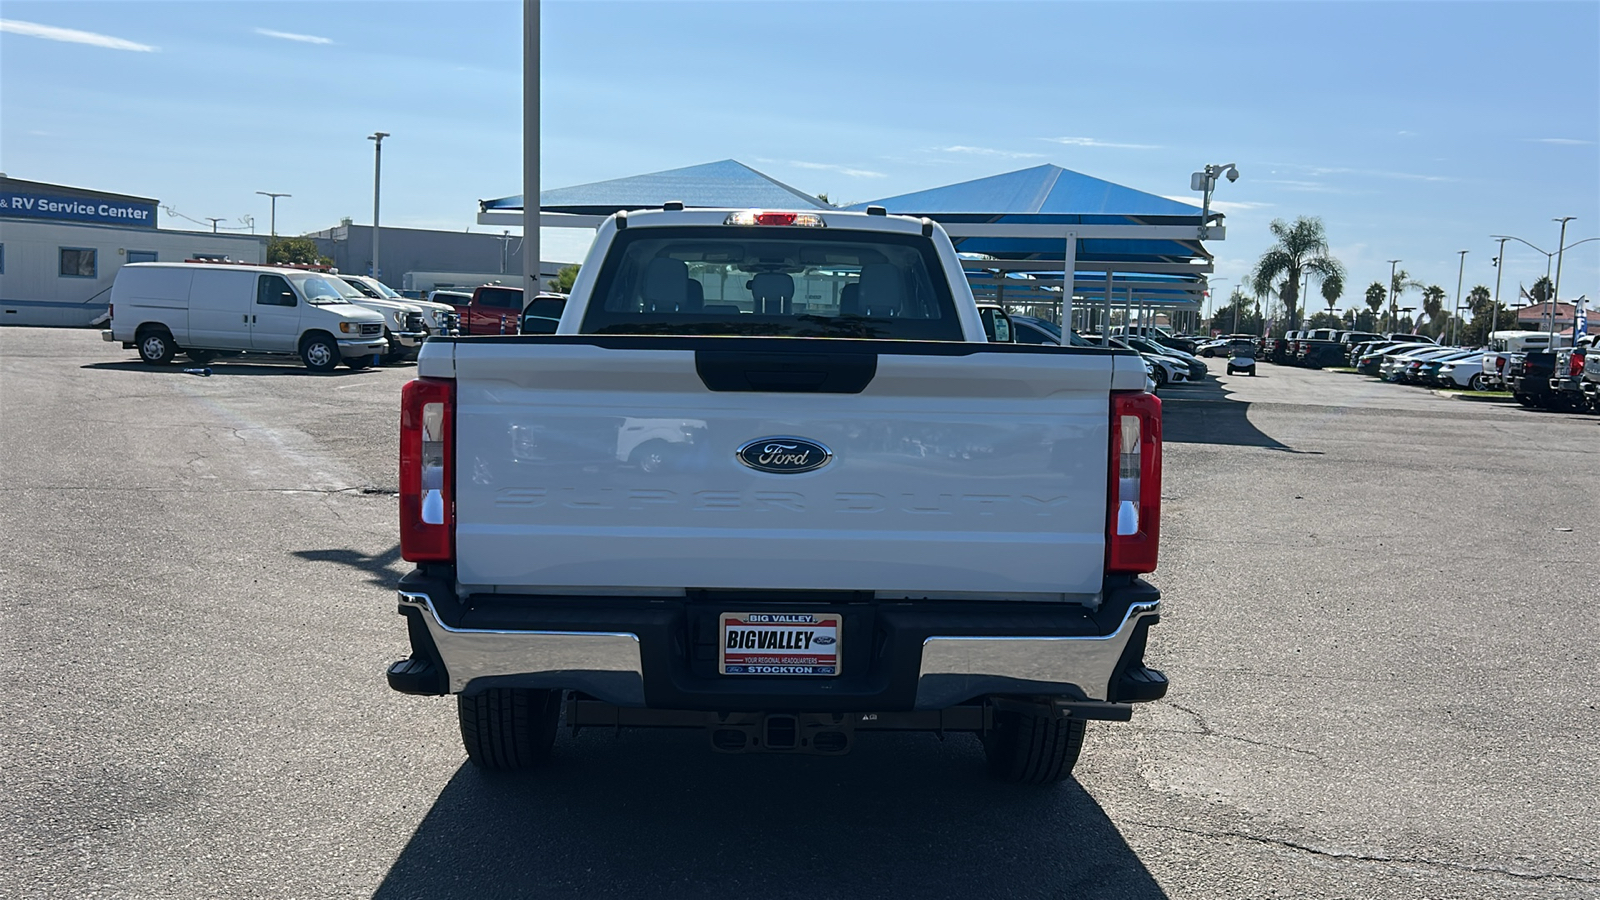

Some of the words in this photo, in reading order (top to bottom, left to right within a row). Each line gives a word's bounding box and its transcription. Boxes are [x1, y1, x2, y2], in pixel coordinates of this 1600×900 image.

[12, 197, 34, 210] RV
[38, 199, 95, 214] Service
[98, 205, 148, 219] Center
[759, 443, 810, 465] Ford
[749, 614, 769, 623] BIG
[772, 615, 812, 623] VALLEY
[727, 630, 814, 649] BIGVALLEY
[748, 666, 813, 674] STOCKTON
